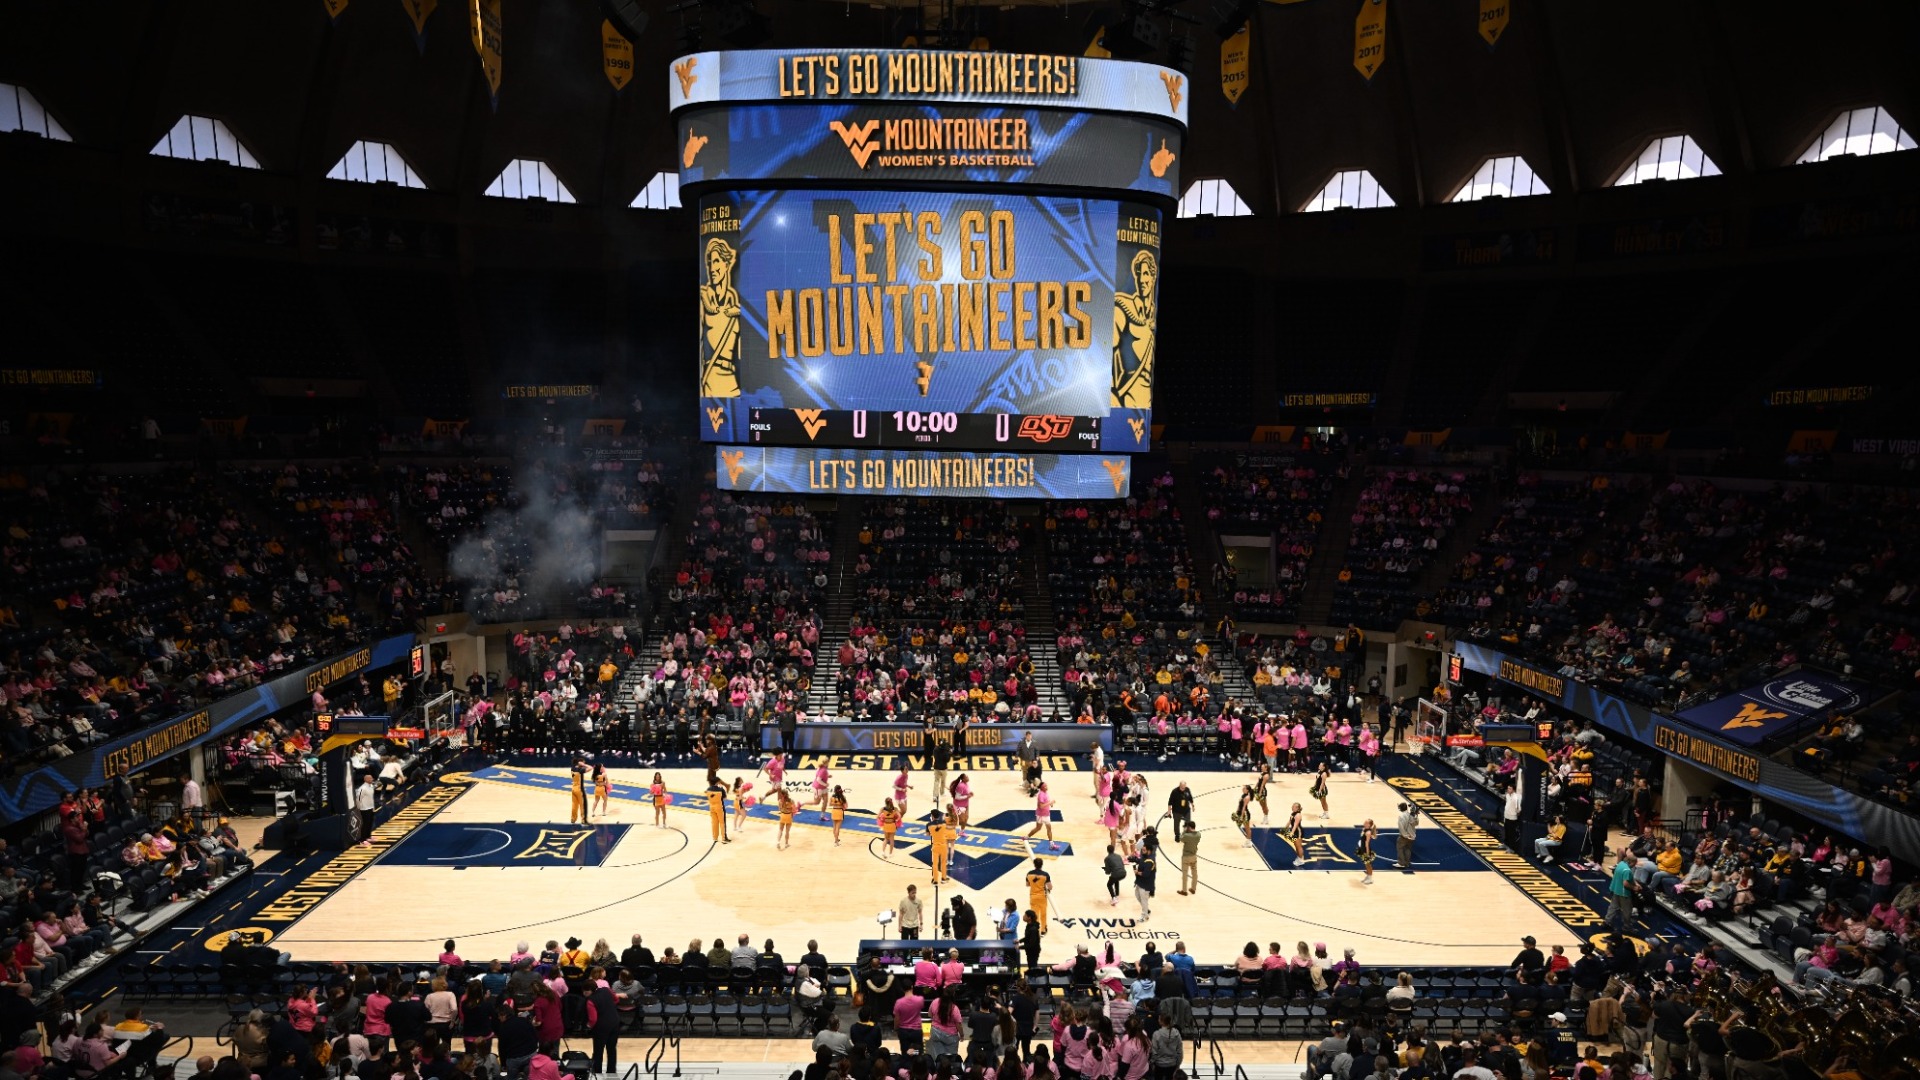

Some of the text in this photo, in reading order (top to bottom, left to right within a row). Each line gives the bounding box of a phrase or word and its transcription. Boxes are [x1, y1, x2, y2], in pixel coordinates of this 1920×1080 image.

[1358, 44, 1382, 58] 2017
[606, 58, 631, 70] 1998
[779, 52, 1076, 97] LET'S GO MOUNTAINEERS!
[1222, 71, 1245, 83] 2015
[885, 118, 1028, 151] MOUNTAINEER
[878, 154, 1035, 168] WOMEN'S BASKETBALL
[1129, 217, 1149, 231] LET'S
[828, 209, 1016, 285] LET'S GO
[765, 281, 1093, 359] MOUNTAINEERS
[507, 385, 526, 398] LET'S
[1770, 390, 1792, 405] LET'S
[1793, 389, 1805, 404] GO
[1284, 393, 1304, 406] LET'S
[750, 423, 771, 431] FOULS
[893, 411, 958, 433] 10:00
[1078, 433, 1100, 441] FOULS
[1852, 438, 1885, 453] WEST
[809, 458, 1035, 489] LET'S GO MOUNTAINEERS!
[1500, 660, 1514, 680] LET'S
[306, 673, 323, 694] LET'S
[322, 670, 330, 686] GO
[318, 722, 330, 731] 30
[873, 731, 901, 748] LET'S
[903, 731, 918, 747] GO
[1539, 730, 1550, 739] 30
[103, 709, 210, 780] LET'S GO MOUNTAINEERS!
[1655, 724, 1760, 783] LET'S GO MOUNTAINEERS!
[797, 755, 899, 770] WEST
[251, 786, 467, 921] WEST VIRGINIA MOUNTAINEERS
[1402, 791, 1605, 927] WEST VIRGINIA MOUNTAINEERS
[1086, 928, 1181, 940] Medicine
